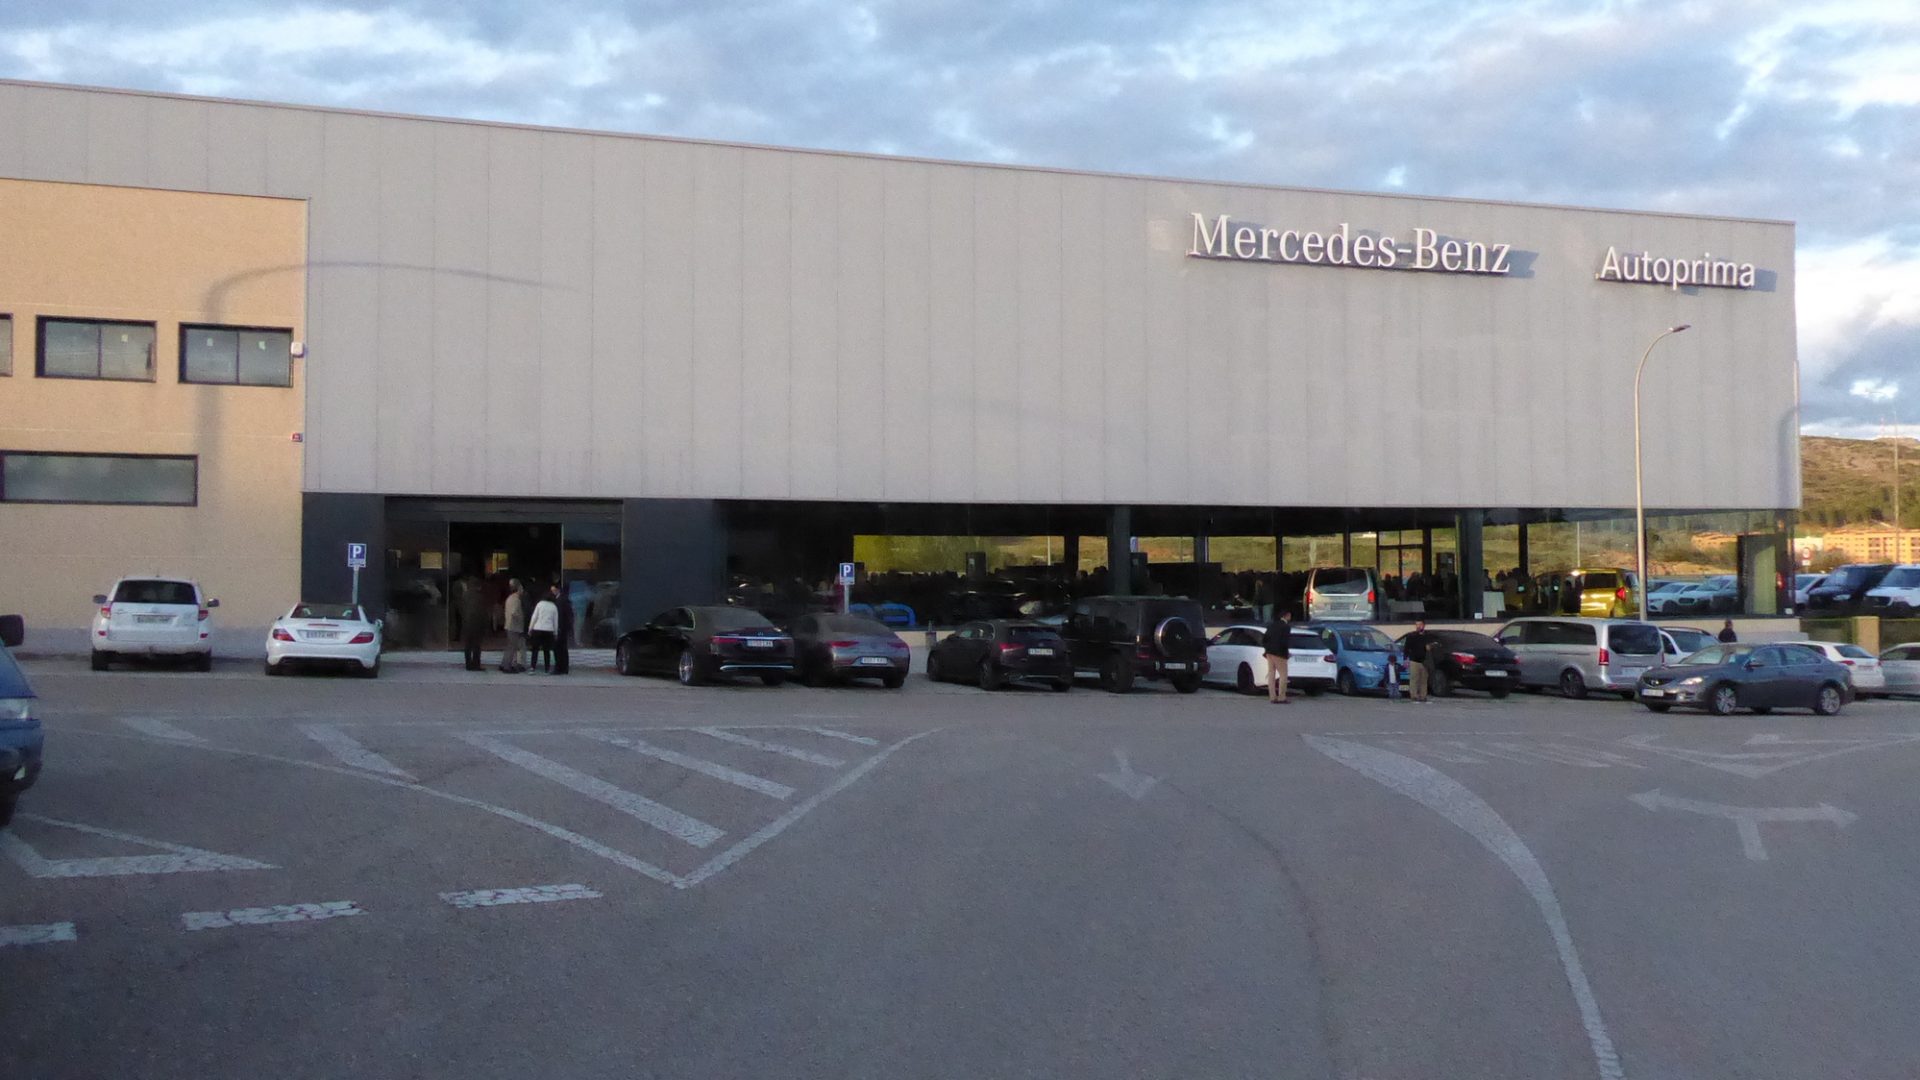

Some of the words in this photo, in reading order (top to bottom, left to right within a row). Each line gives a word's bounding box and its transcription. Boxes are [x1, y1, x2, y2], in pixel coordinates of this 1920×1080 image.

[1188, 212, 1511, 273] Mercedes-Benz
[1600, 246, 1755, 290] Autoprima
[353, 545, 362, 558] P
[843, 564, 851, 577] P
